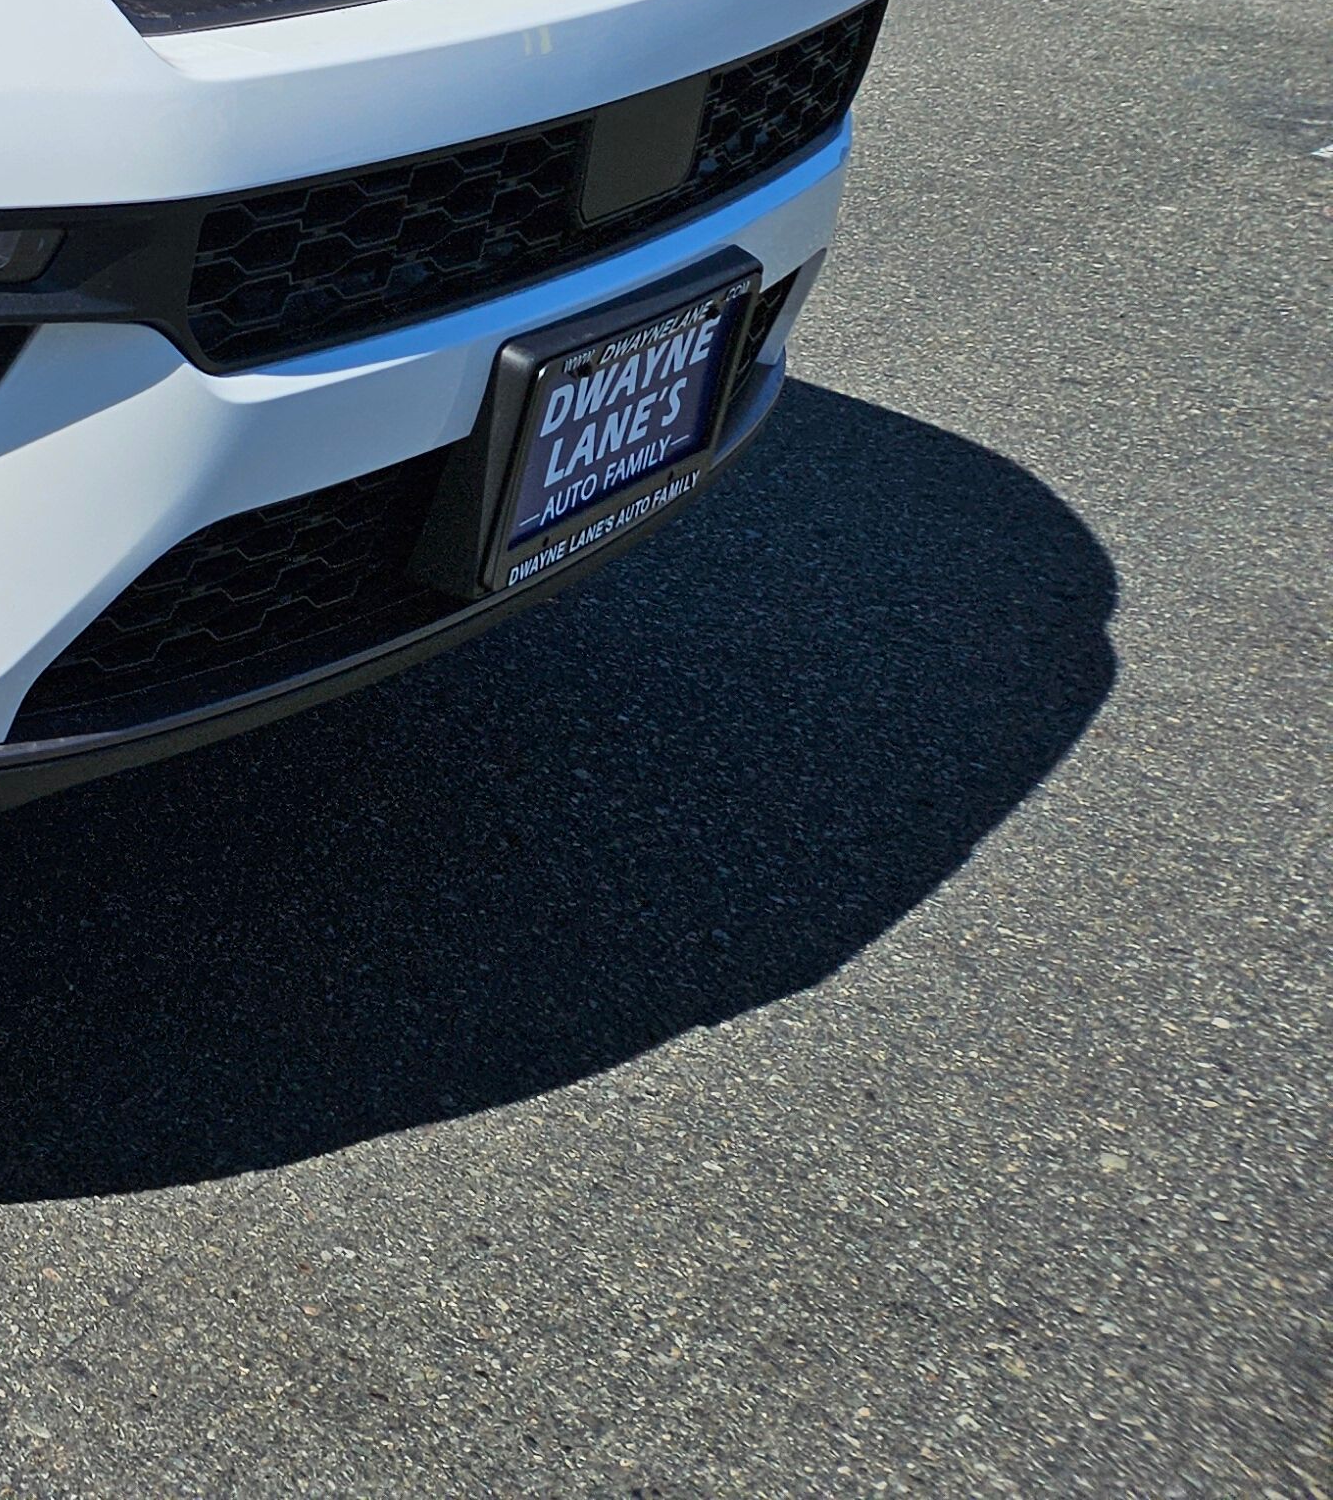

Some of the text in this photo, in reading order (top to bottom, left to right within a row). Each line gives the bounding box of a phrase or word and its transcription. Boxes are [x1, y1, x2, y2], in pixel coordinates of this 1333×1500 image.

[540, 314, 721, 437] DWAYNE
[540, 435, 671, 526] AUTO FAMILY
[544, 378, 687, 488] LANE'S
[508, 470, 700, 586] DWAYNE LANE'S AUTO FAMILY
